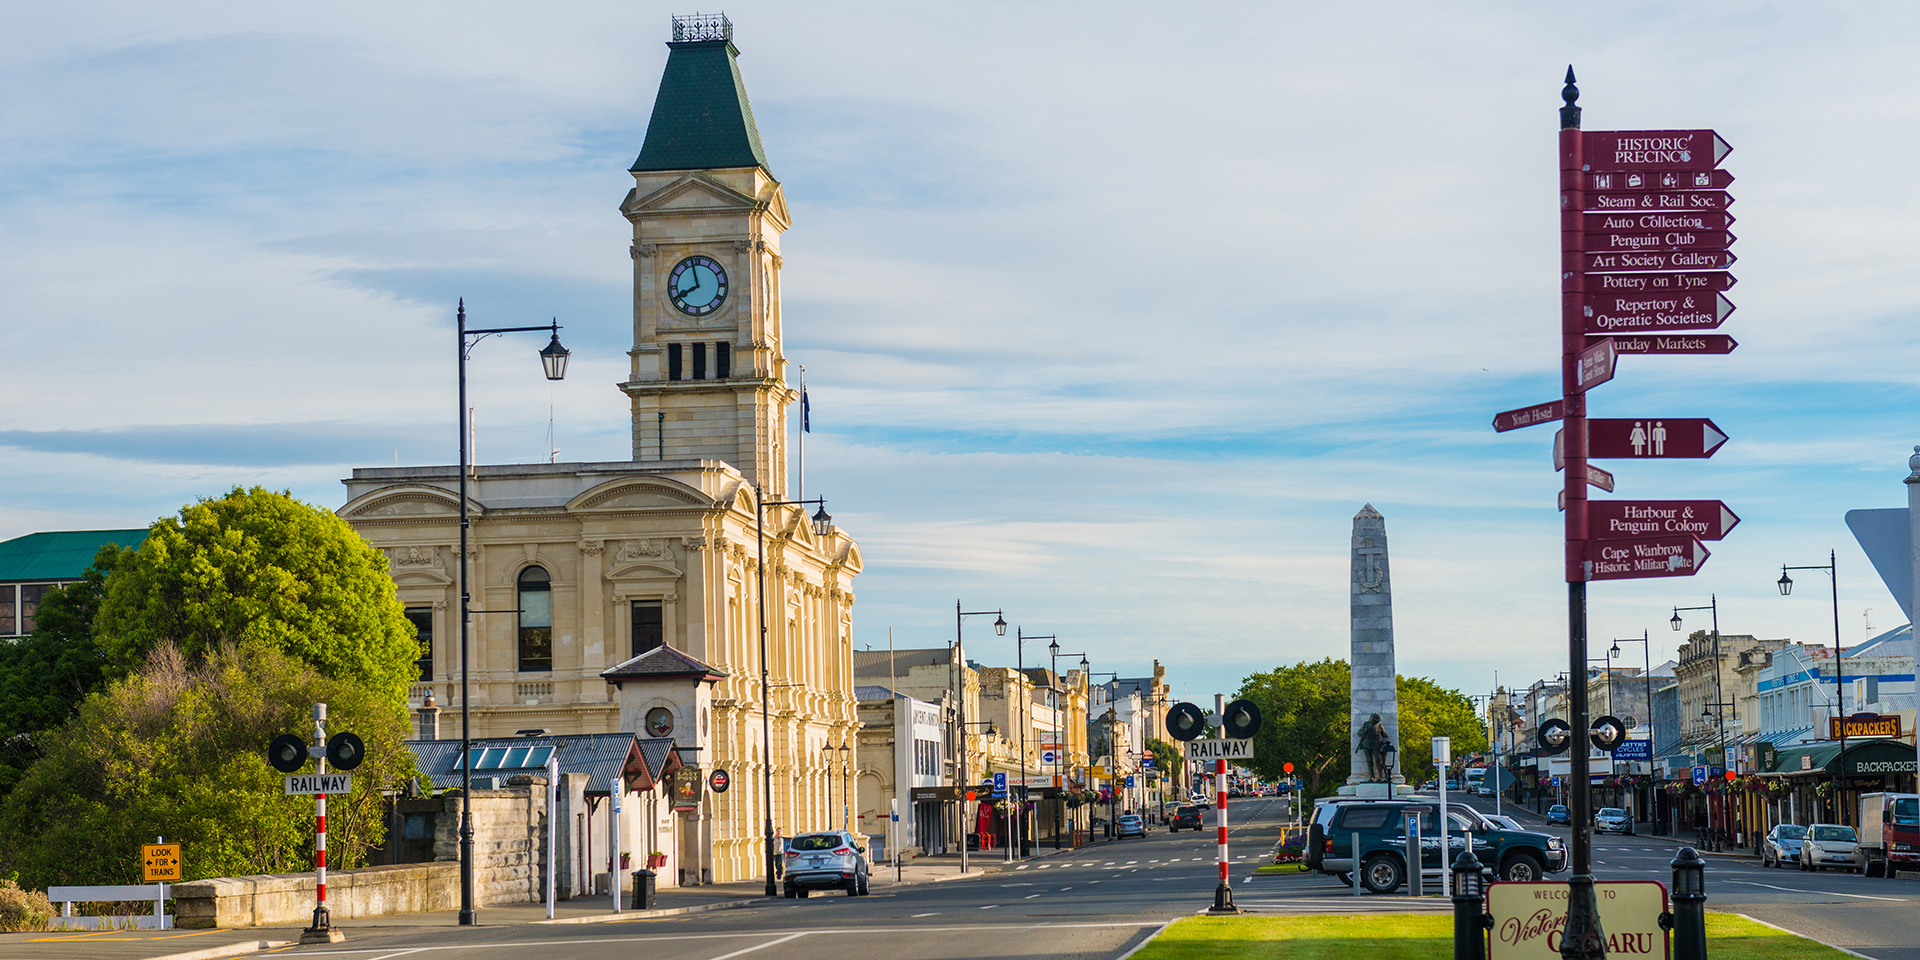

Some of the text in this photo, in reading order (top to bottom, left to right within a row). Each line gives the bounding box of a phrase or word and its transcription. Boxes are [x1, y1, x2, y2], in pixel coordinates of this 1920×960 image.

[1617, 138, 1688, 150] HISTORIC
[1615, 150, 1691, 163] PRECINCT
[1598, 194, 1715, 207] Steam & Rail Soc.
[1603, 215, 1702, 228] Auto Collection
[1610, 232, 1695, 249] Penguin Club
[1593, 253, 1717, 269] Art Society Gallery
[1603, 274, 1708, 290] Pottery on Tyne
[1615, 296, 1695, 314] Repertory &
[1597, 311, 1712, 329] Operatic Societies
[1614, 337, 1706, 353] unday Markets
[1512, 406, 1552, 426] Youth Hostel
[1624, 506, 1694, 519] Harbour &
[1610, 518, 1709, 534] Penguin Colony
[1601, 544, 1684, 562] Cape Wanbrow
[1595, 560, 1631, 573] Historic
[1634, 558, 1669, 572] Military
[1191, 741, 1247, 757] RAILWAY
[1856, 761, 1918, 772] BACKPACKER
[291, 776, 347, 791] RAILWAY
[151, 848, 172, 857] LOOK
[155, 858, 168, 866] FOR
[150, 868, 174, 876] TRAINS
[1533, 890, 1616, 899] WELCO TO
[1500, 908, 1568, 946] Victori
[1547, 931, 1653, 953] OARU
